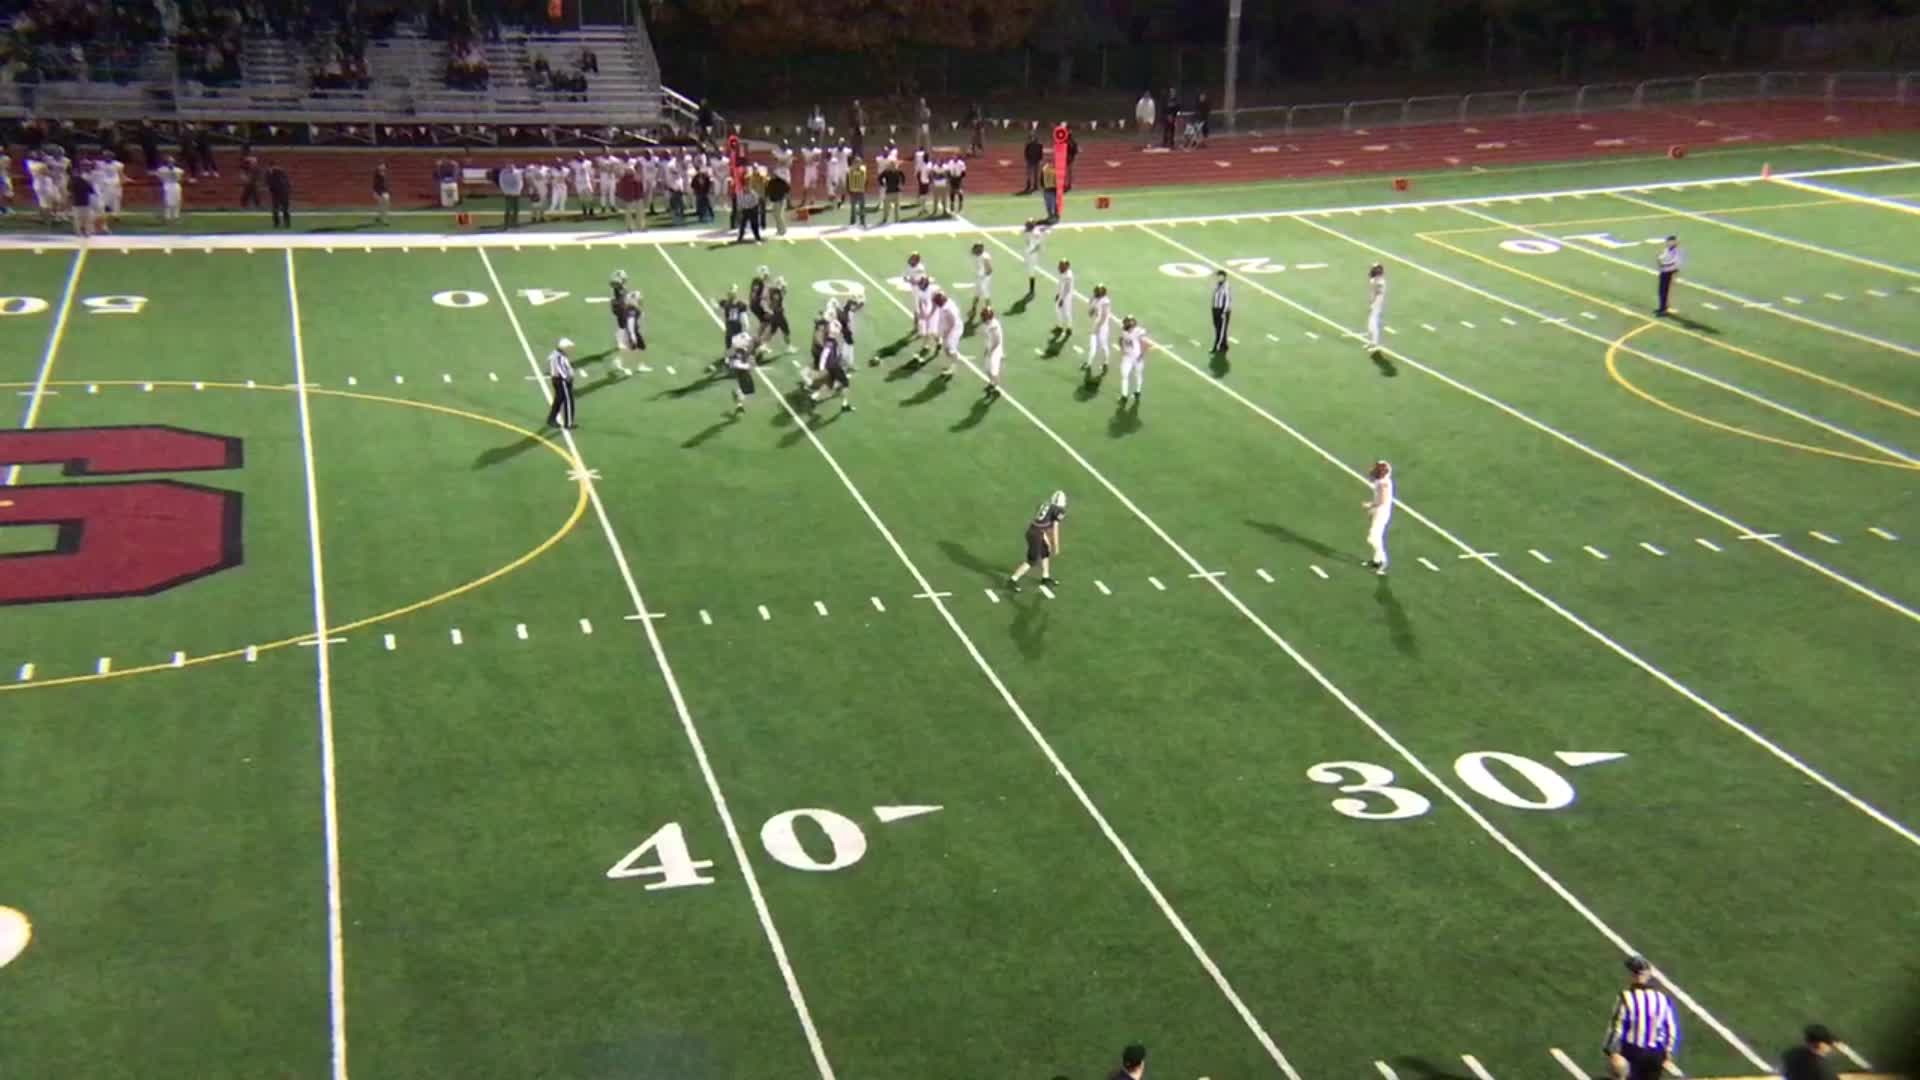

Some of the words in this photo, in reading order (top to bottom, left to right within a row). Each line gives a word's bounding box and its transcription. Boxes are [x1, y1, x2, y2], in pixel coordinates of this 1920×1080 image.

[1158, 258, 1285, 278] 20
[432, 290, 570, 308] 40
[1306, 751, 1573, 819] 30
[608, 807, 867, 889] 40
